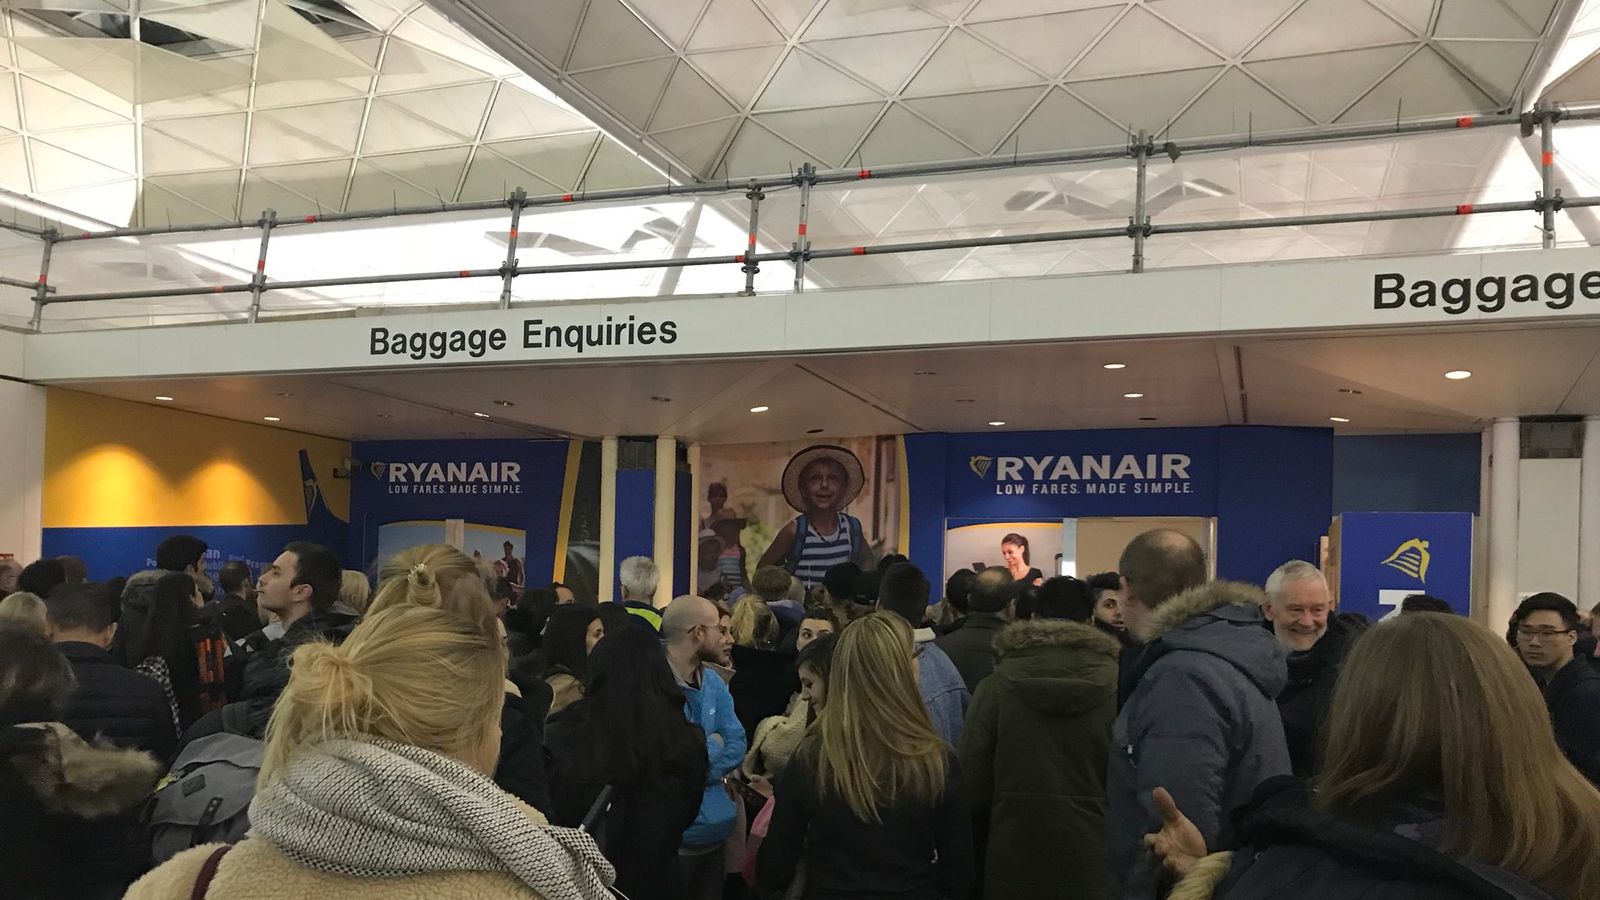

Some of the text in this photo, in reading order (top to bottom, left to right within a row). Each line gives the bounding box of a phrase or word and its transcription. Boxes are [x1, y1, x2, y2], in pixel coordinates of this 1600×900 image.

[1374, 270, 1600, 314] Baggage
[370, 315, 678, 360] Baggage Enquiries
[389, 462, 521, 483] RYANAIR
[997, 454, 1191, 481] RYANAIR
[388, 485, 408, 494] LOW
[450, 485, 477, 494] MADE
[997, 482, 1194, 494] LOW FARES. MADE SIMPLE.
